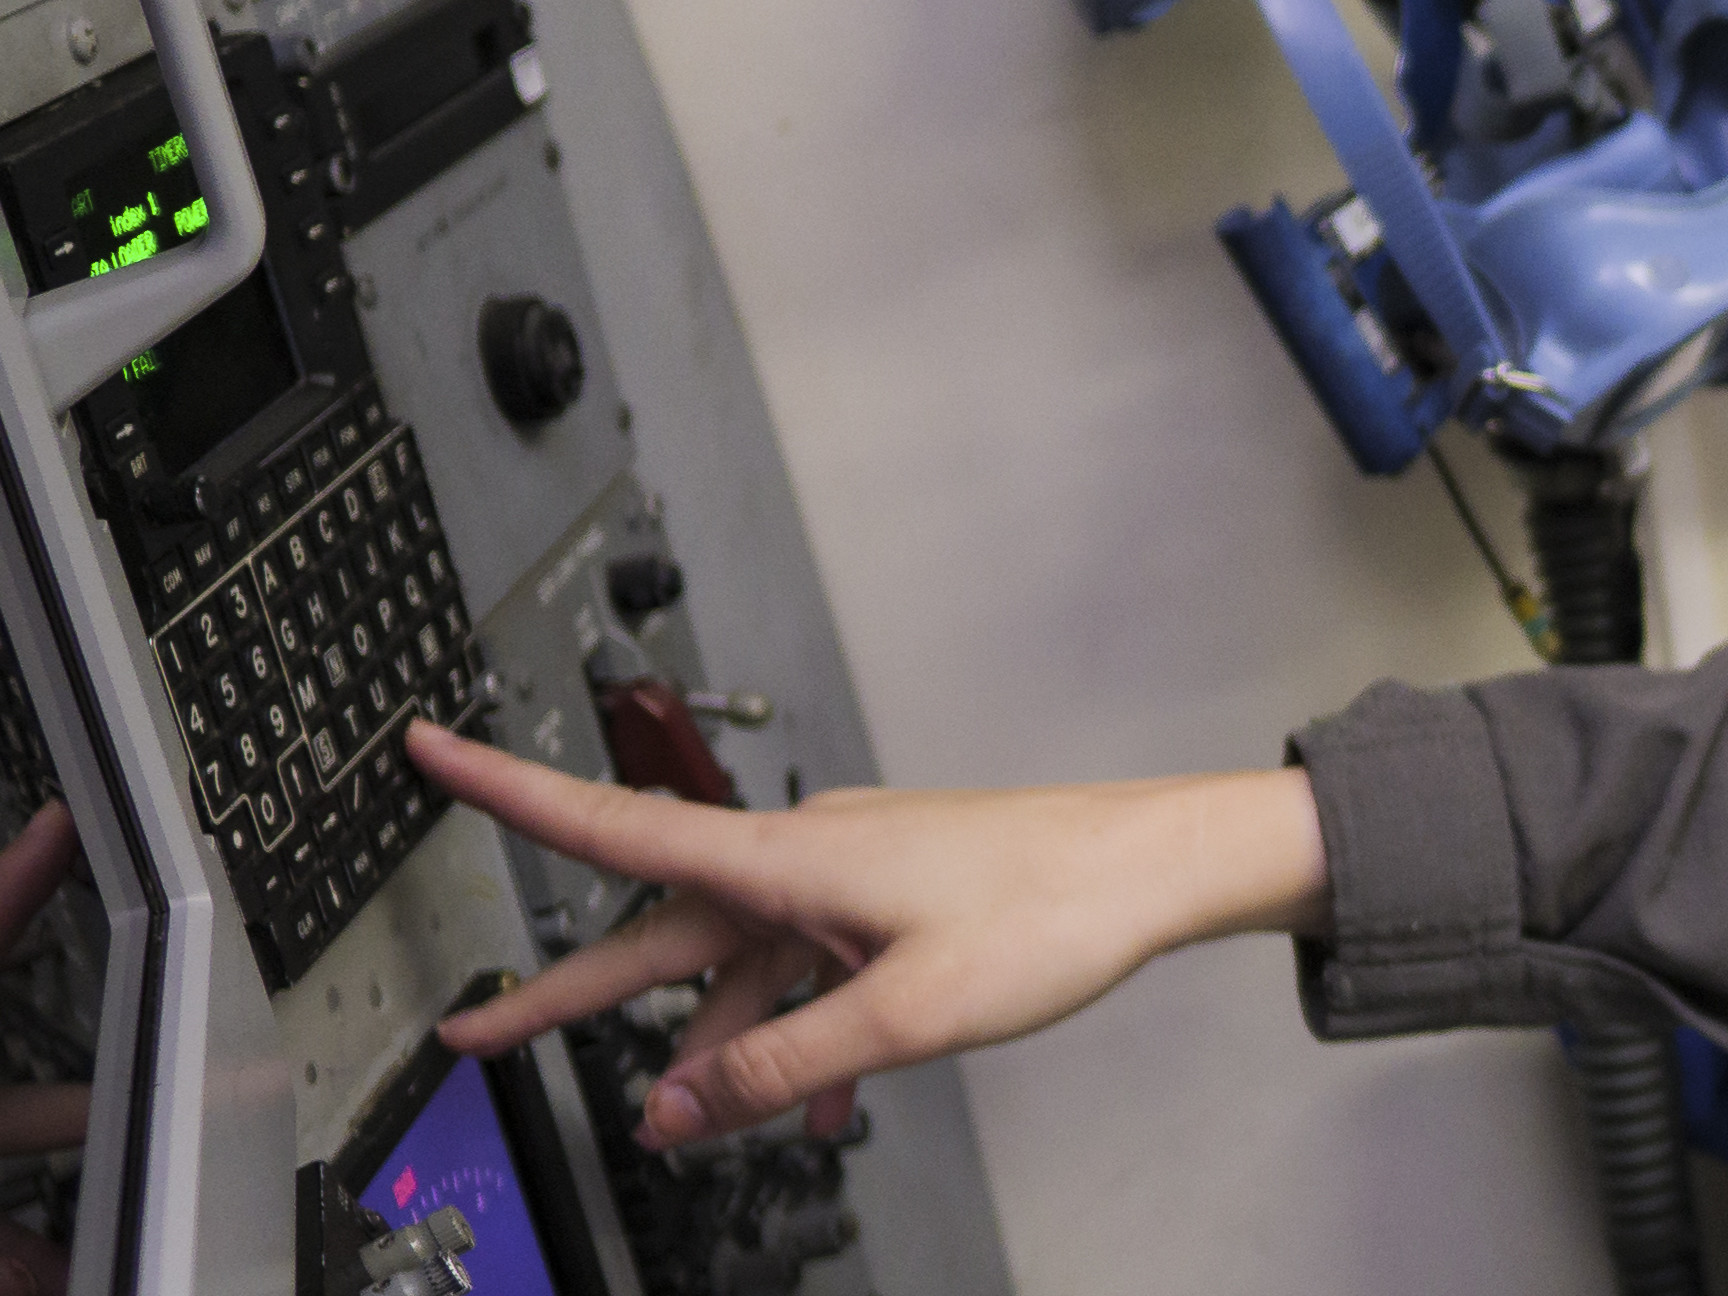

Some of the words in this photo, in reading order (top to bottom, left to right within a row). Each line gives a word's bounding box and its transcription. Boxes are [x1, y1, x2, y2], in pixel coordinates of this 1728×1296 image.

[163, 566, 184, 594] COM
[263, 561, 279, 596] A
[289, 535, 307, 570] B
[319, 510, 334, 543] C
[344, 487, 361, 523] D
[280, 618, 296, 651] G
[307, 591, 325, 628] H
[337, 567, 350, 600] I
[365, 542, 379, 576] J
[387, 520, 404, 554] K
[411, 503, 429, 533] L
[169, 640, 183, 673] 1
[201, 612, 220, 649] 2
[230, 584, 248, 619] 3
[298, 674, 317, 713] M
[353, 623, 369, 656] O
[377, 598, 392, 633] P
[189, 703, 206, 735] 4
[220, 672, 237, 708] 5
[252, 645, 267, 680] 6
[343, 704, 359, 739] T
[369, 677, 386, 712] U
[393, 651, 411, 687] V
[449, 668, 465, 703] Z
[206, 759, 223, 796] 7
[240, 732, 257, 768] 8
[269, 704, 286, 739] 9
[260, 792, 276, 826] 0
